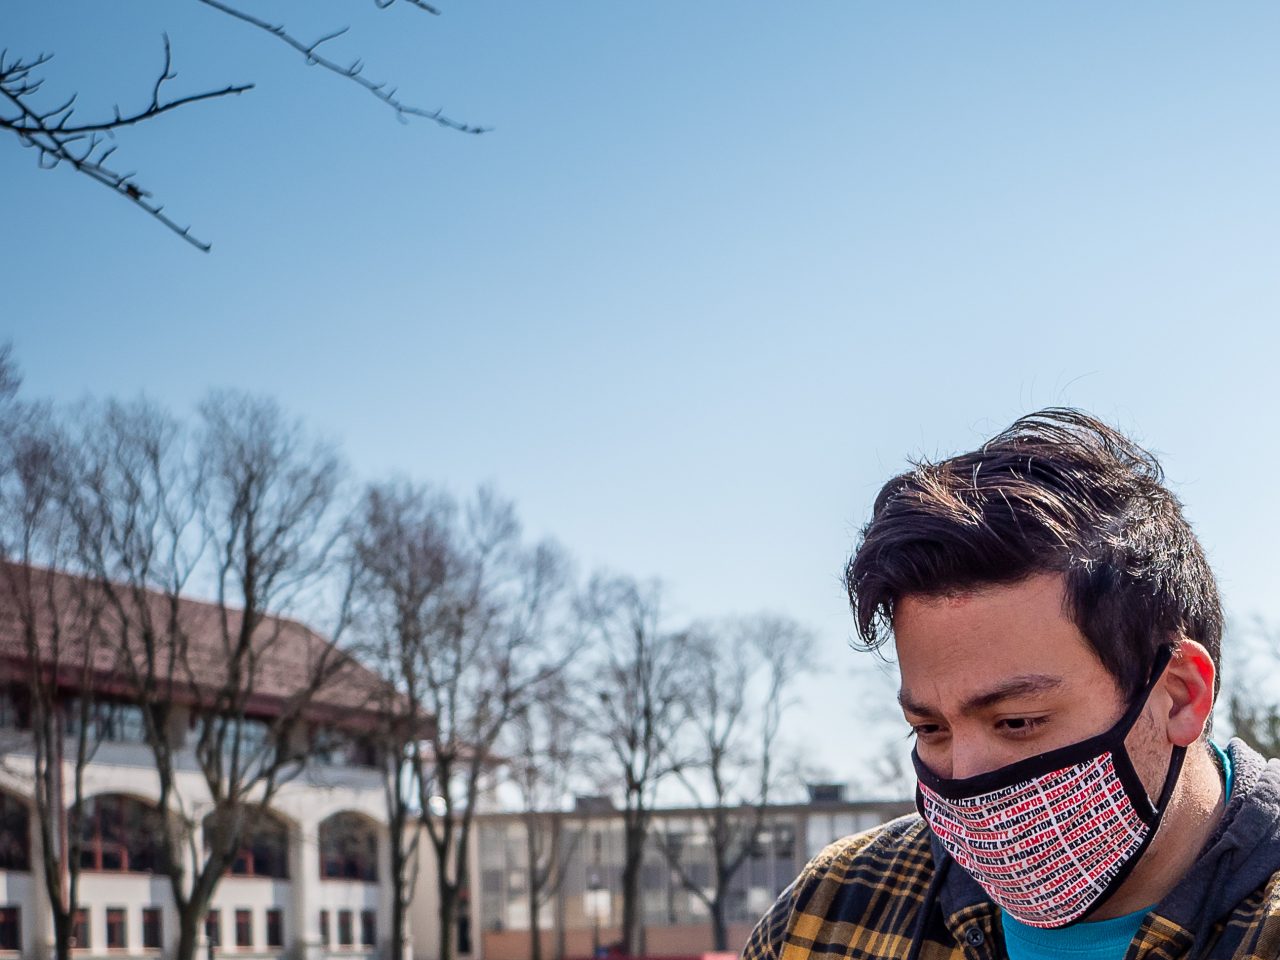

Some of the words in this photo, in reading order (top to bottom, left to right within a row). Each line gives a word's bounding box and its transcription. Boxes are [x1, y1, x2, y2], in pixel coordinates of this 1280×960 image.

[957, 810, 985, 821] ALTH
[986, 789, 1040, 816] PROMOTION
[1041, 769, 1078, 792] HEALTH
[979, 780, 1034, 805] PROMOTION
[994, 805, 1047, 831] PROMOTION
[1048, 783, 1082, 807] HEALTH
[1083, 770, 1101, 786] PRO
[1038, 765, 1073, 785] RECRE
[943, 819, 964, 835] STATE
[1012, 812, 1049, 835] CAMPUS
[1051, 781, 1099, 815] RECREATI
[963, 813, 1002, 828] ERSITY
[1005, 796, 1044, 819] CAMPUS
[968, 840, 998, 850] HEALTH
[1000, 819, 1053, 849] PROMOTION
[1054, 799, 1087, 824] HEALT
[975, 854, 1006, 866] HEALTH
[1007, 835, 1060, 864] PROMOTION
[1061, 810, 1094, 836] HEALTH
[1093, 799, 1112, 815] PRO
[1019, 829, 1057, 849] CAMPUS
[1058, 791, 1107, 832] REEATION
[990, 875, 1031, 887] VERSITY
[1034, 854, 1072, 878] CAMPUS
[1072, 821, 1124, 857] RECREATION
[1015, 847, 1067, 878] PROMOTION
[1068, 827, 1102, 851] HEALTH
[1102, 815, 1120, 831] PRO
[1026, 841, 1063, 865] CAMPUS
[1063, 807, 1117, 844] RECREATION
[994, 887, 1041, 899] UERSITY
[1043, 867, 1080, 891] CAMPUS
[1080, 829, 1129, 868] RECREATION
[1024, 861, 1076, 891] PROMOTION
[1076, 839, 1109, 863] HEALTH
[1033, 872, 1084, 904] PROMOTION
[1084, 848, 1116, 873] HEALTH
[1007, 901, 1050, 912] VERSITY
[1053, 877, 1089, 904] CAMPUS
